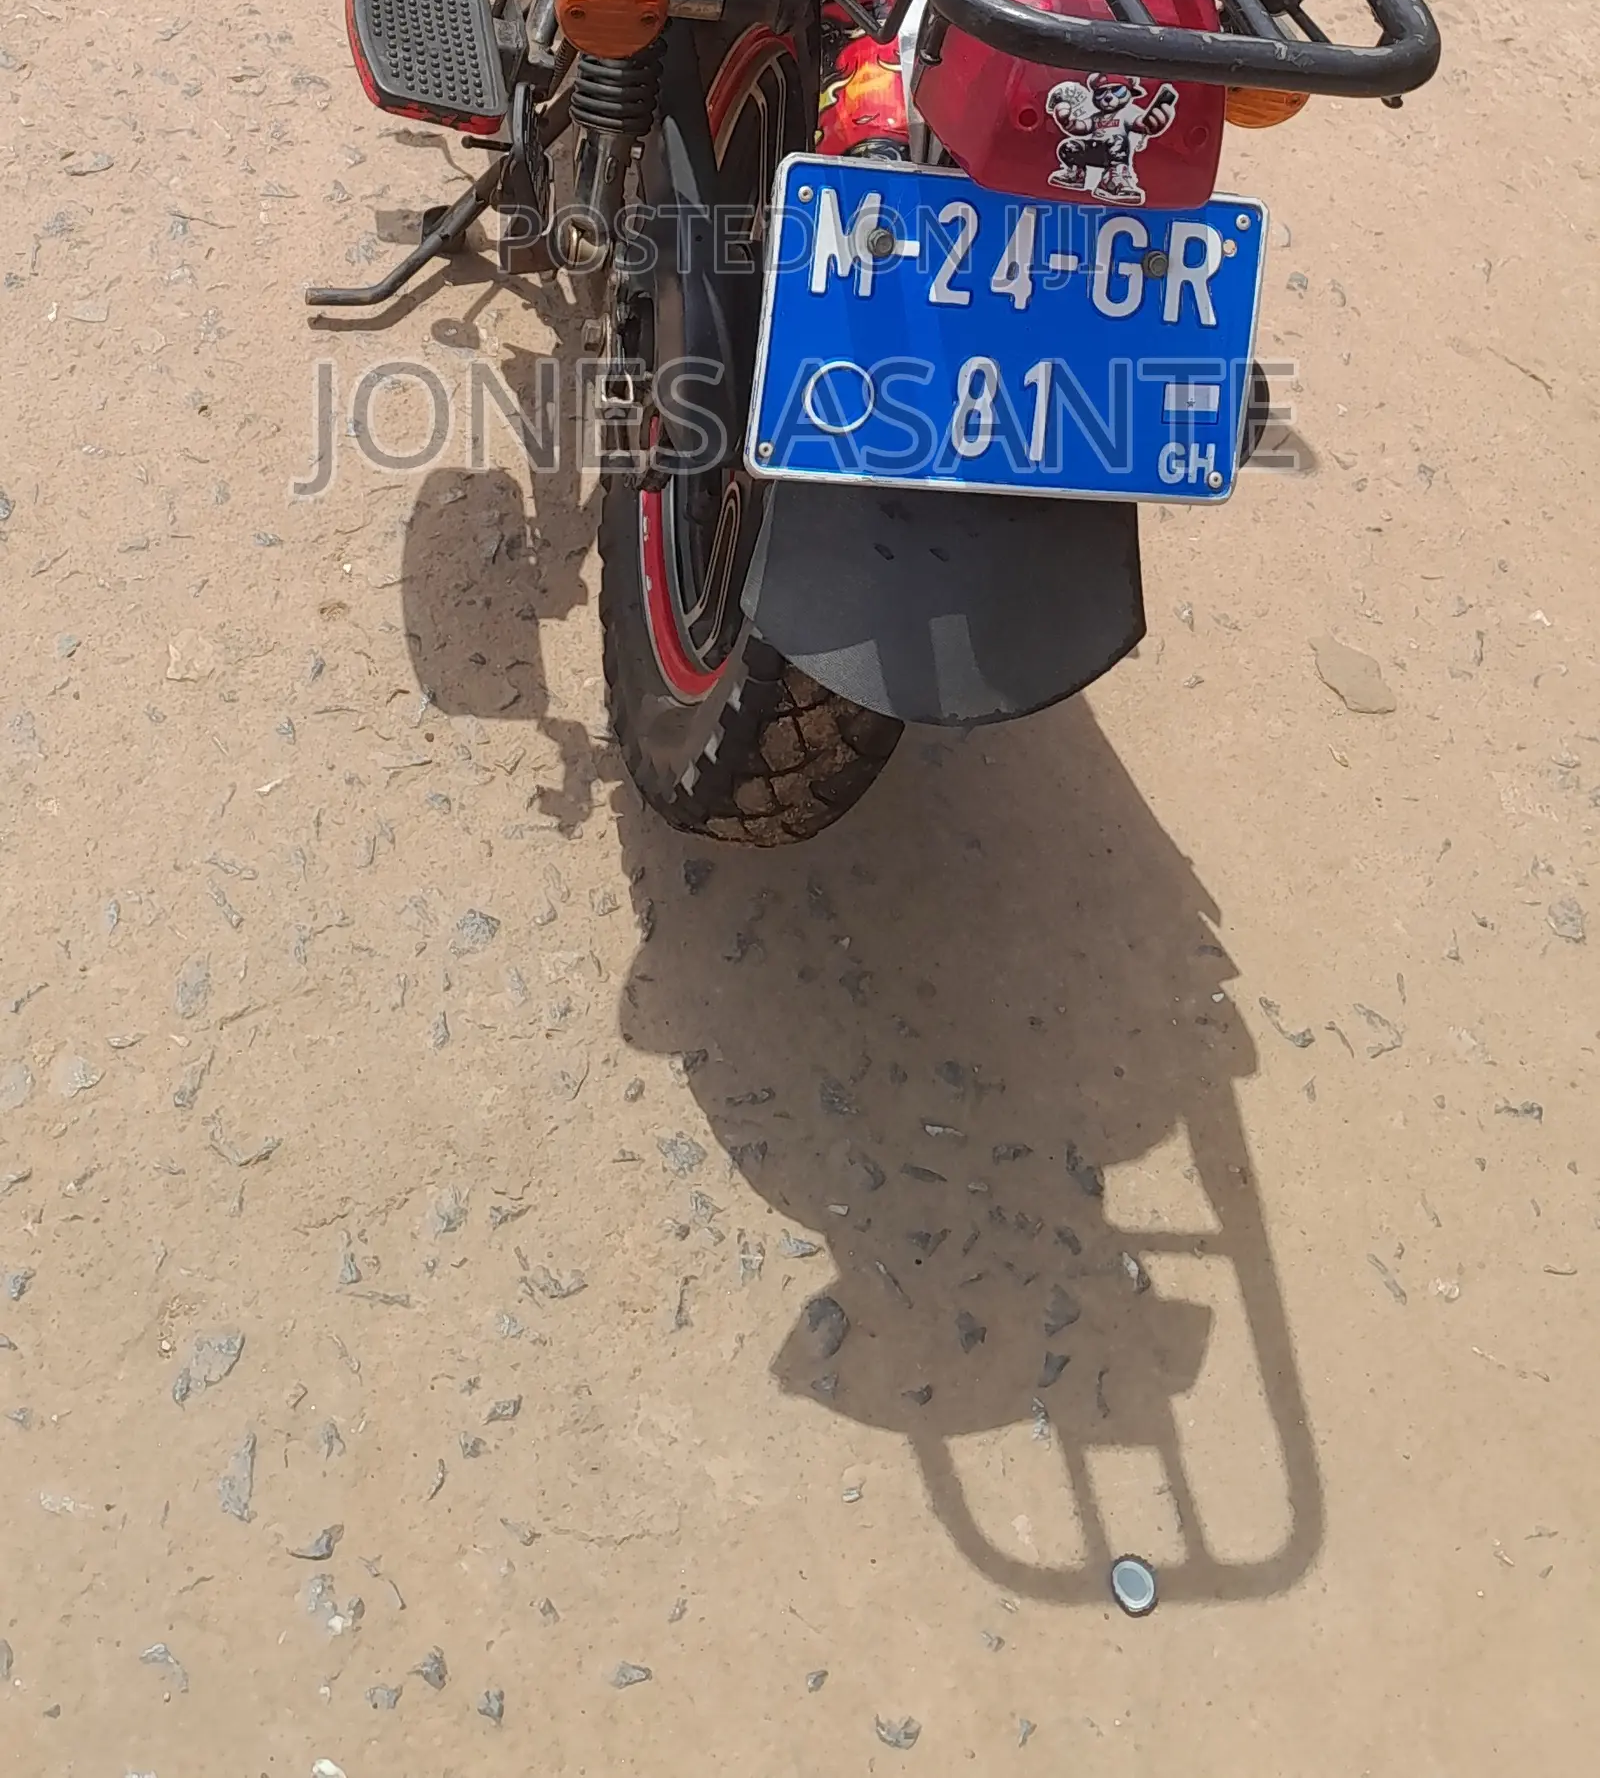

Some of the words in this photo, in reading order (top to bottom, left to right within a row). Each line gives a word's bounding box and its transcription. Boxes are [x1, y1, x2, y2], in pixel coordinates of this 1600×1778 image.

[810, 188, 1217, 325] M-24-GR
[951, 355, 1053, 462] 81
[1157, 441, 1217, 485] GH
